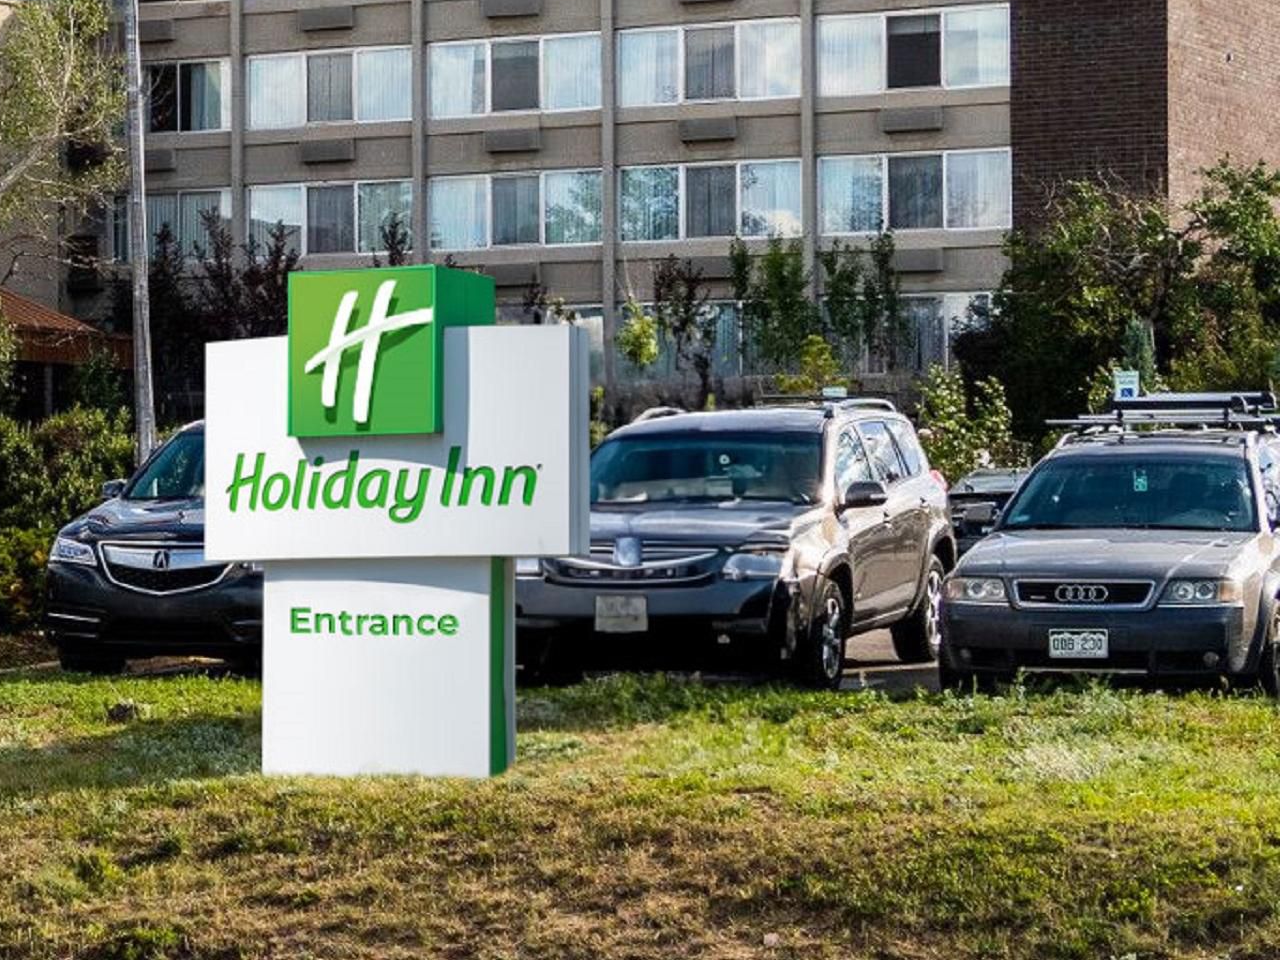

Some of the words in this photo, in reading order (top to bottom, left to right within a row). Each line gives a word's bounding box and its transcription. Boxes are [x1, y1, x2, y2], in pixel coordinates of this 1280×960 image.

[225, 449, 431, 524] Holiday
[441, 445, 538, 507] Inn
[290, 607, 460, 636] Entrance
